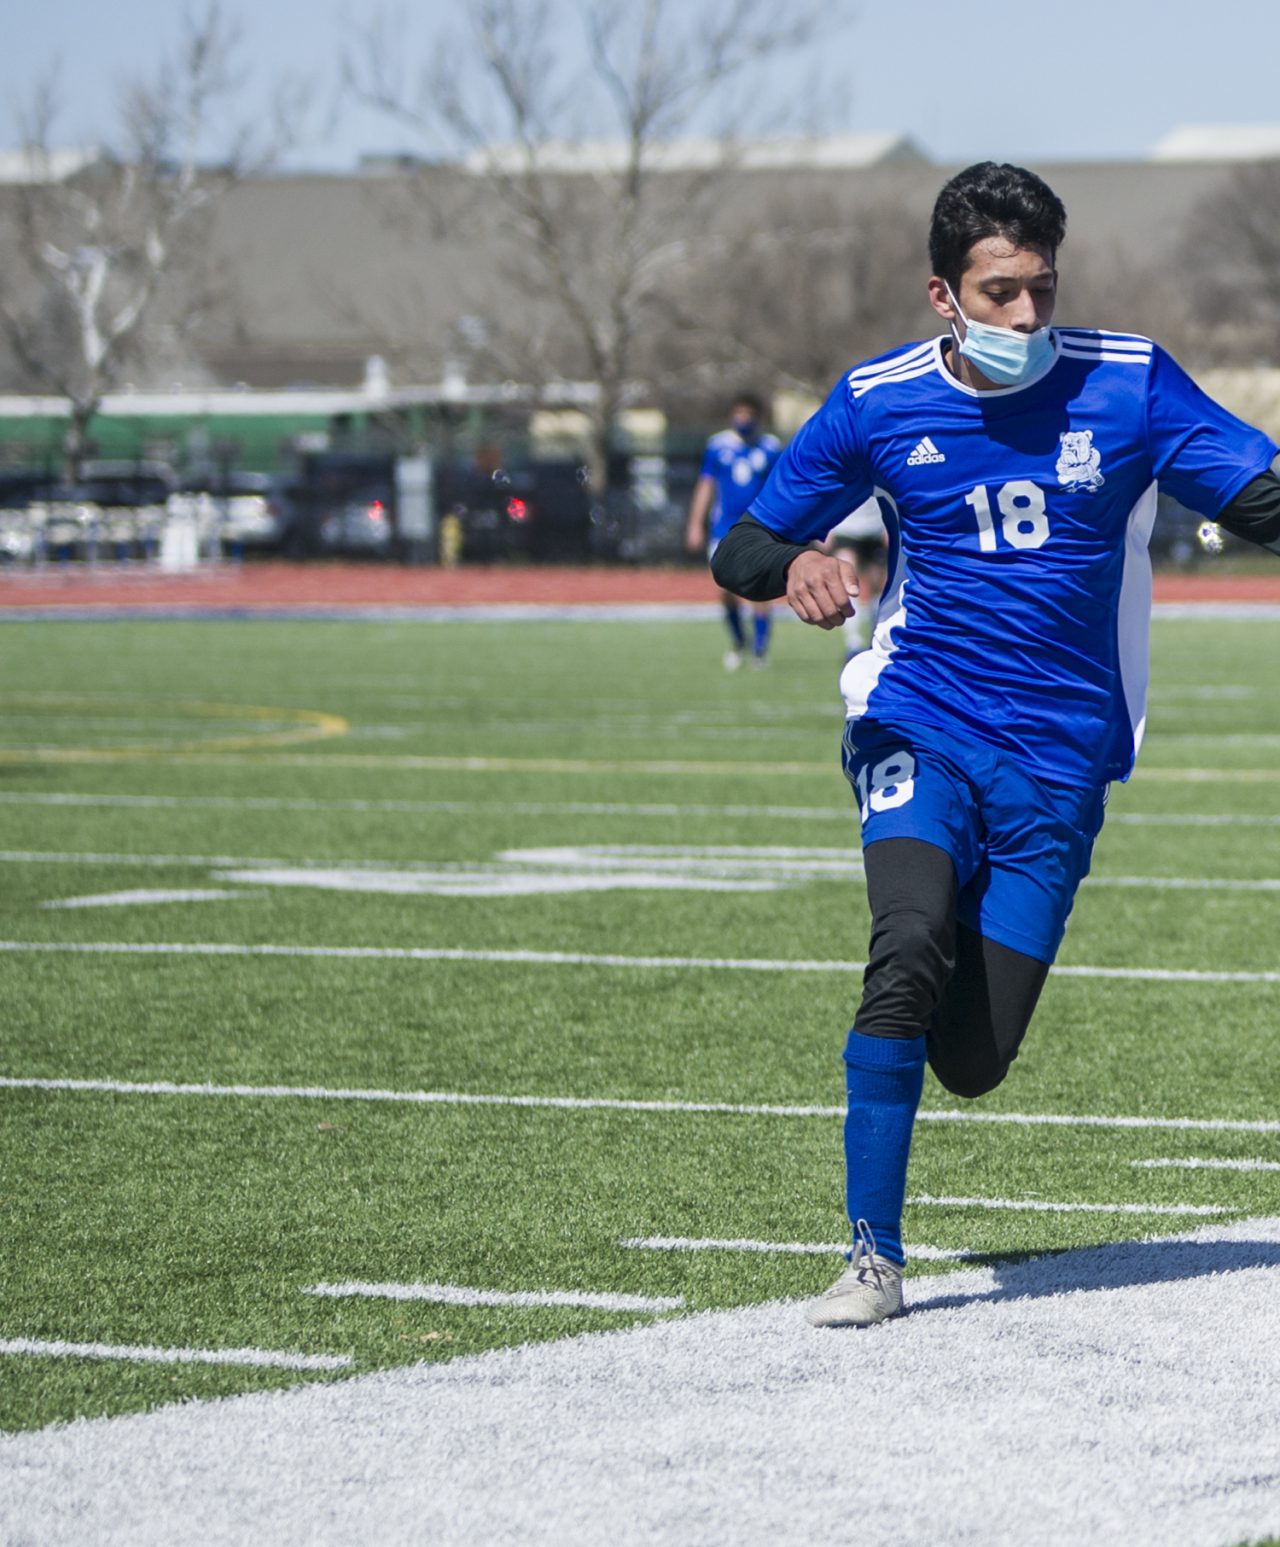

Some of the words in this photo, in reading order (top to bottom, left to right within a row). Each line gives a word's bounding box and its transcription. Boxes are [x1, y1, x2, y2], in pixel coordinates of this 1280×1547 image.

[907, 453, 946, 466] adidas
[964, 480, 1050, 552] 18
[856, 750, 915, 824] 18
